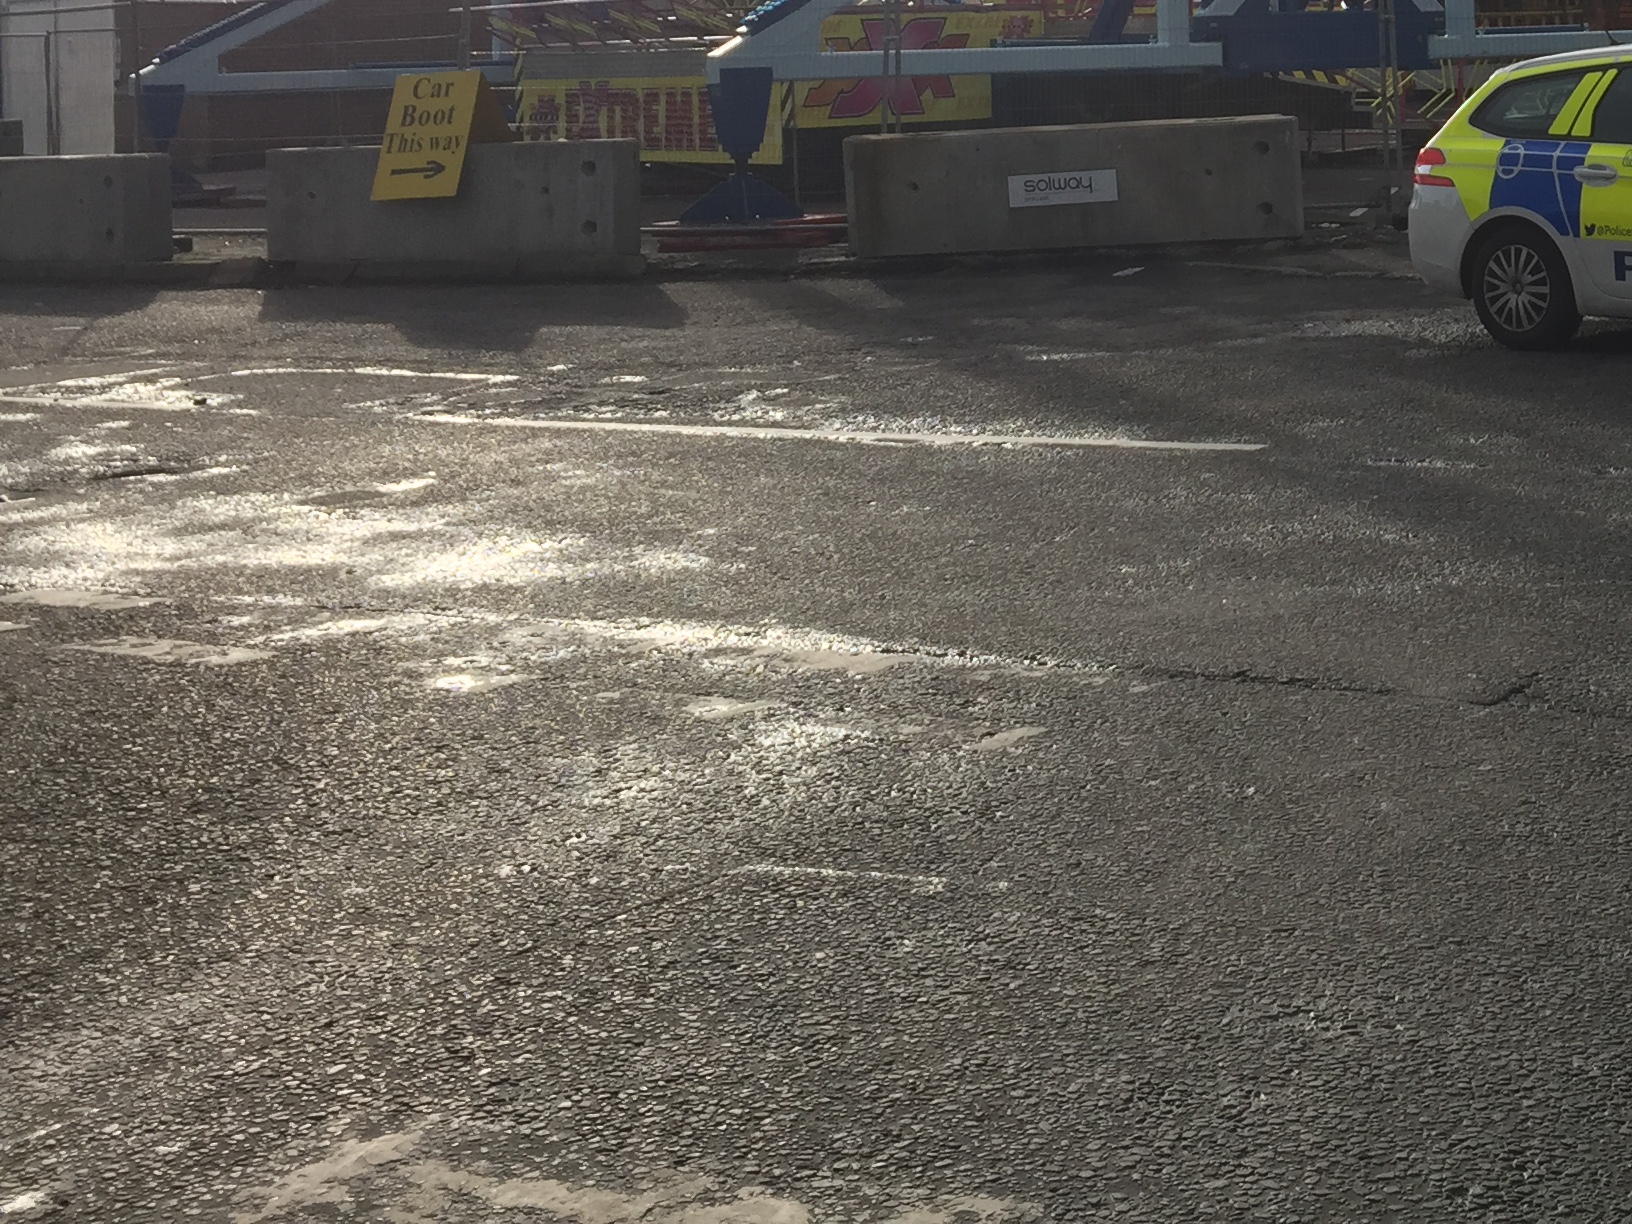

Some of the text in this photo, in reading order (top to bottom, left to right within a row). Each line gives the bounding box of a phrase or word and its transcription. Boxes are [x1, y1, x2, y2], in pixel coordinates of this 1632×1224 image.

[412, 77, 455, 100] Car
[400, 104, 456, 128] Boot
[385, 132, 463, 155] This way
[1023, 176, 1094, 194] solway
